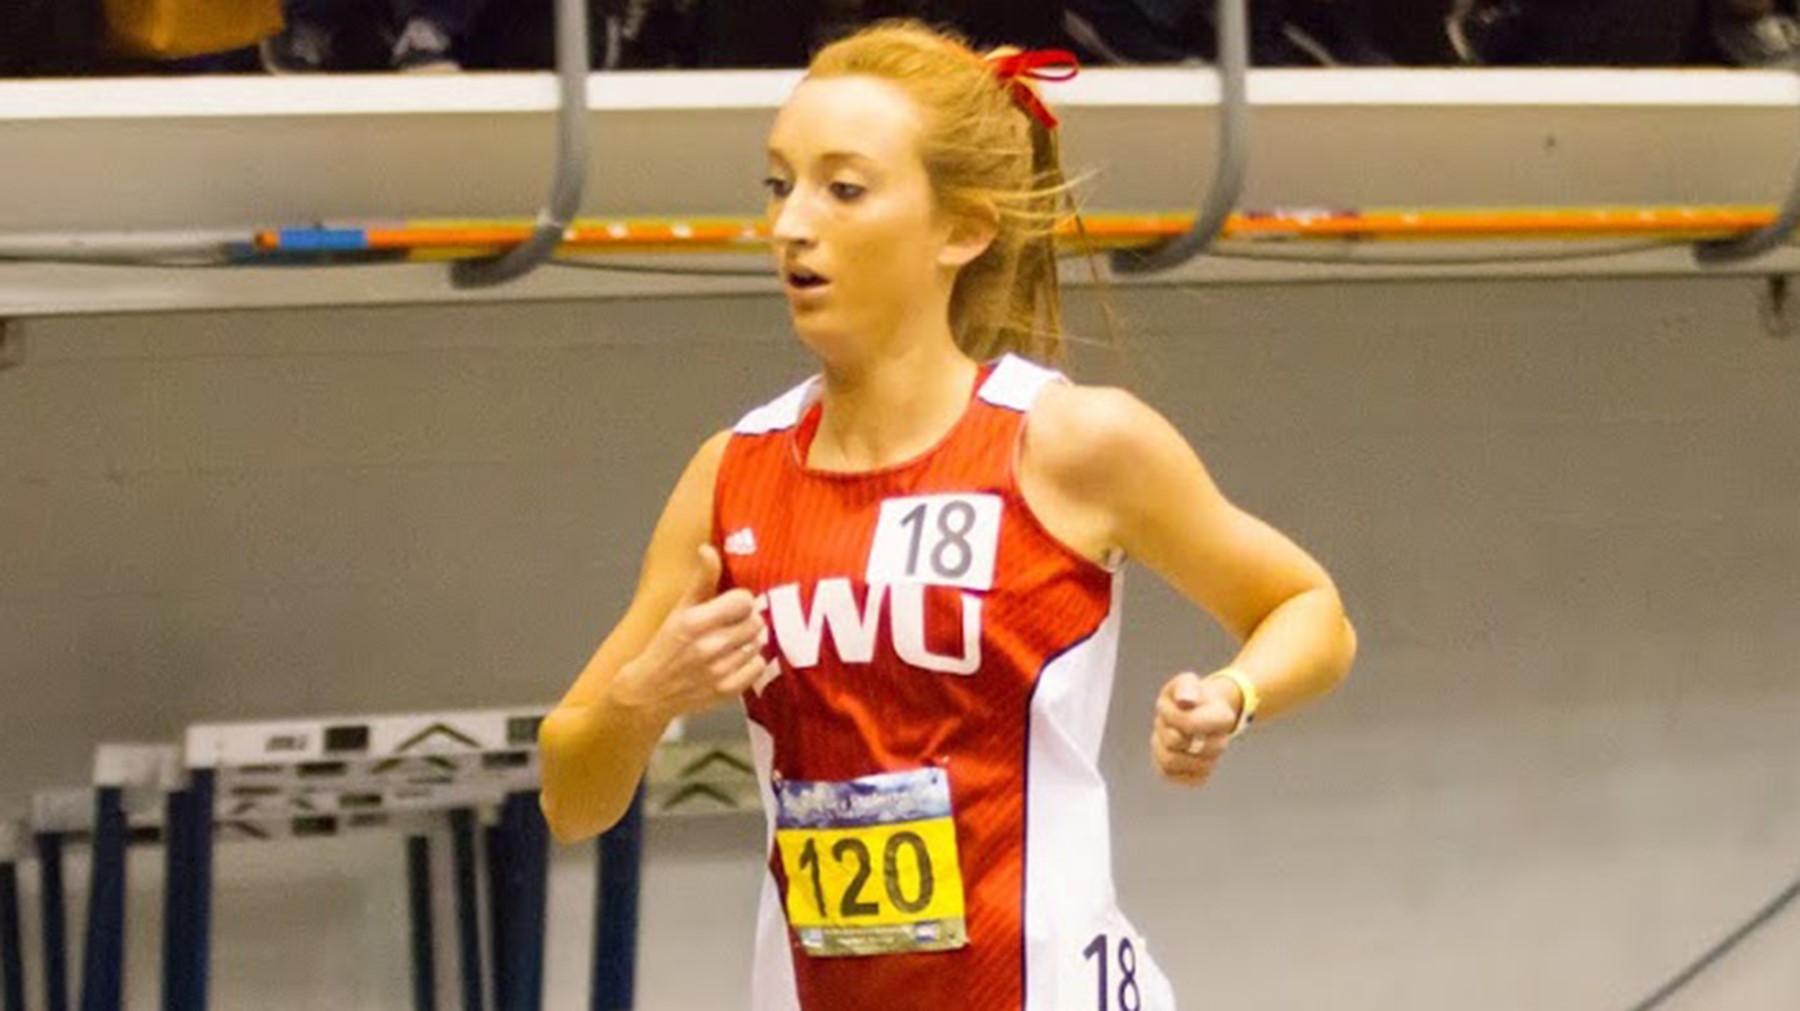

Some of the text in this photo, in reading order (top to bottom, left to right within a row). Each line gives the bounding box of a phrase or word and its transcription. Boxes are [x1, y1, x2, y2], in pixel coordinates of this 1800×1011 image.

[900, 499, 976, 578] 18
[799, 831, 935, 918] 120
[1082, 933, 1141, 1011] 18
